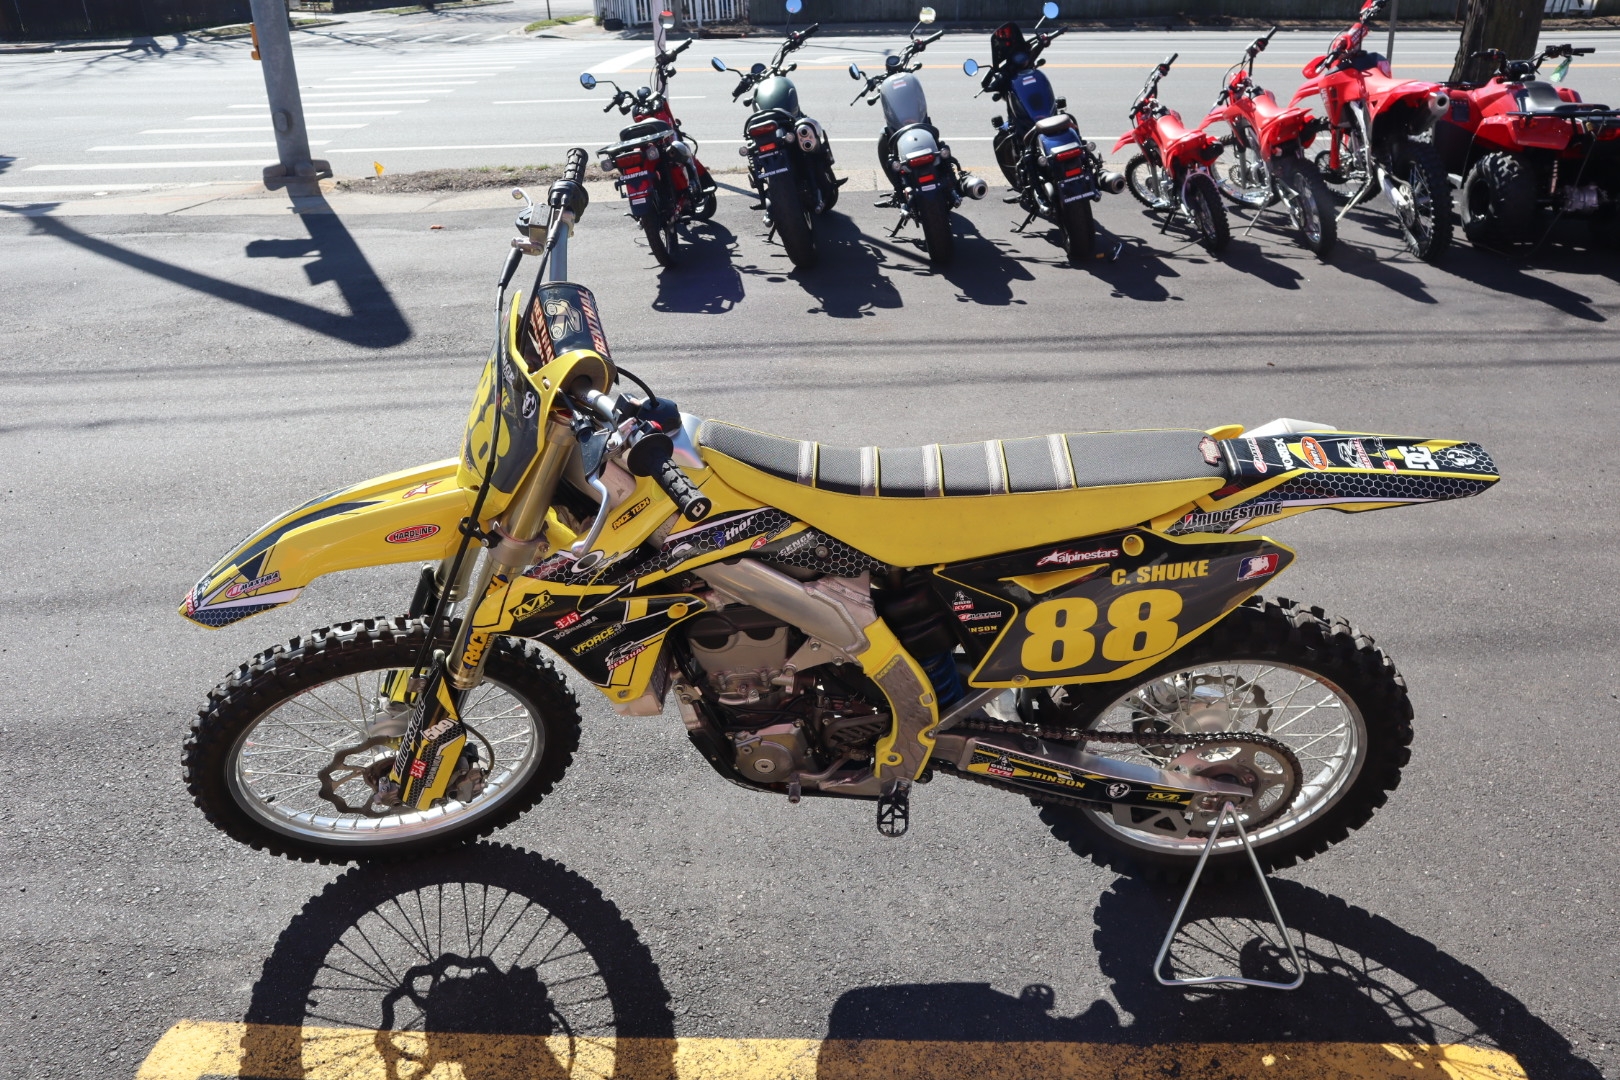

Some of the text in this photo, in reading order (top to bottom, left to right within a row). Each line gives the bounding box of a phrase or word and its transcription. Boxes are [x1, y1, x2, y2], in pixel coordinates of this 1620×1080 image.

[620, 170, 648, 181] CHAMPION
[577, 290, 610, 356] RENTHAL
[1273, 438, 1297, 470] VORTEX
[613, 498, 650, 529] RACE TECH
[1183, 501, 1283, 529] BRIDGESTONE
[393, 526, 432, 540] HARDLINE
[725, 515, 756, 541] thor
[779, 531, 814, 557] SENGE
[1057, 549, 1119, 564] alpinestars
[1111, 559, 1209, 586] C. SHUKE
[553, 616, 598, 639] YOSHIMURA
[1021, 589, 1184, 672] 88
[608, 645, 648, 670] RENTHAL
[1032, 772, 1086, 789] HINSON
